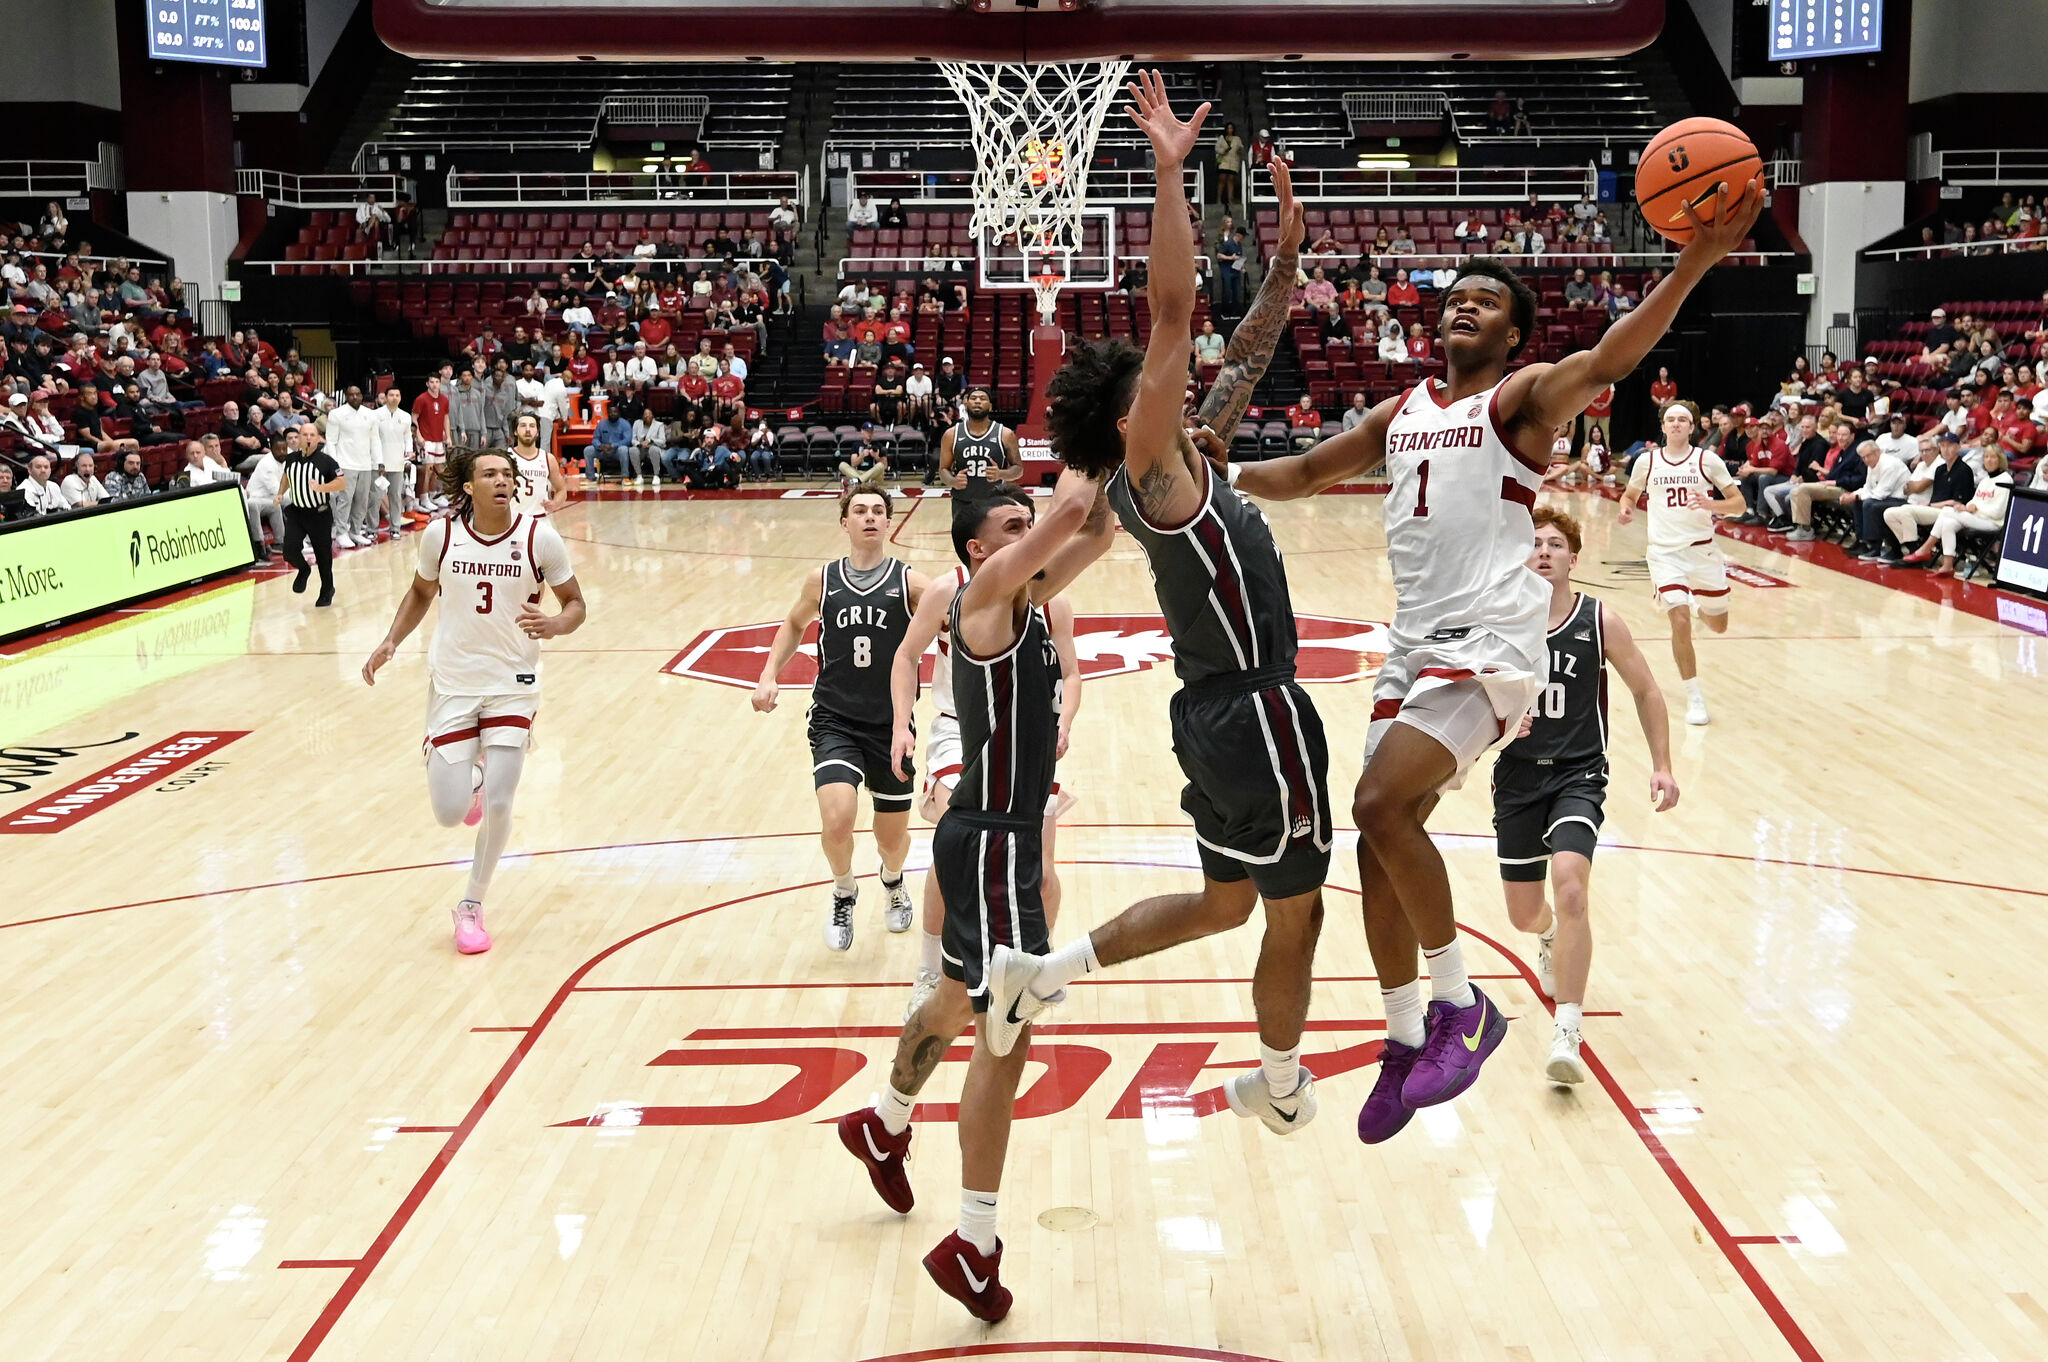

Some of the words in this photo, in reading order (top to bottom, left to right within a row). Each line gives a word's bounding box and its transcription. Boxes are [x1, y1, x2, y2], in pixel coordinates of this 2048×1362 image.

[159, 10, 178, 24] 0.0
[230, 17, 260, 31] 100.0
[236, 39, 255, 52] 0.0
[962, 445, 991, 459] GRIZ
[1389, 425, 1484, 455] STANFORD
[966, 459, 988, 478] 32
[1653, 475, 1699, 486] STANFORD
[524, 479, 534, 497] 5
[1412, 459, 1430, 518] 1
[1665, 486, 1689, 508] 20
[147, 518, 226, 565] Robinhood
[2021, 513, 2045, 555] 11
[4, 564, 64, 602] Move.
[452, 560, 522, 579] STANFORD
[475, 581, 494, 615] 3
[836, 604, 888, 630] GRIZ
[852, 635, 872, 668] 8
[8, 736, 220, 826] VANDERVEER
[155, 760, 231, 793] COURT
